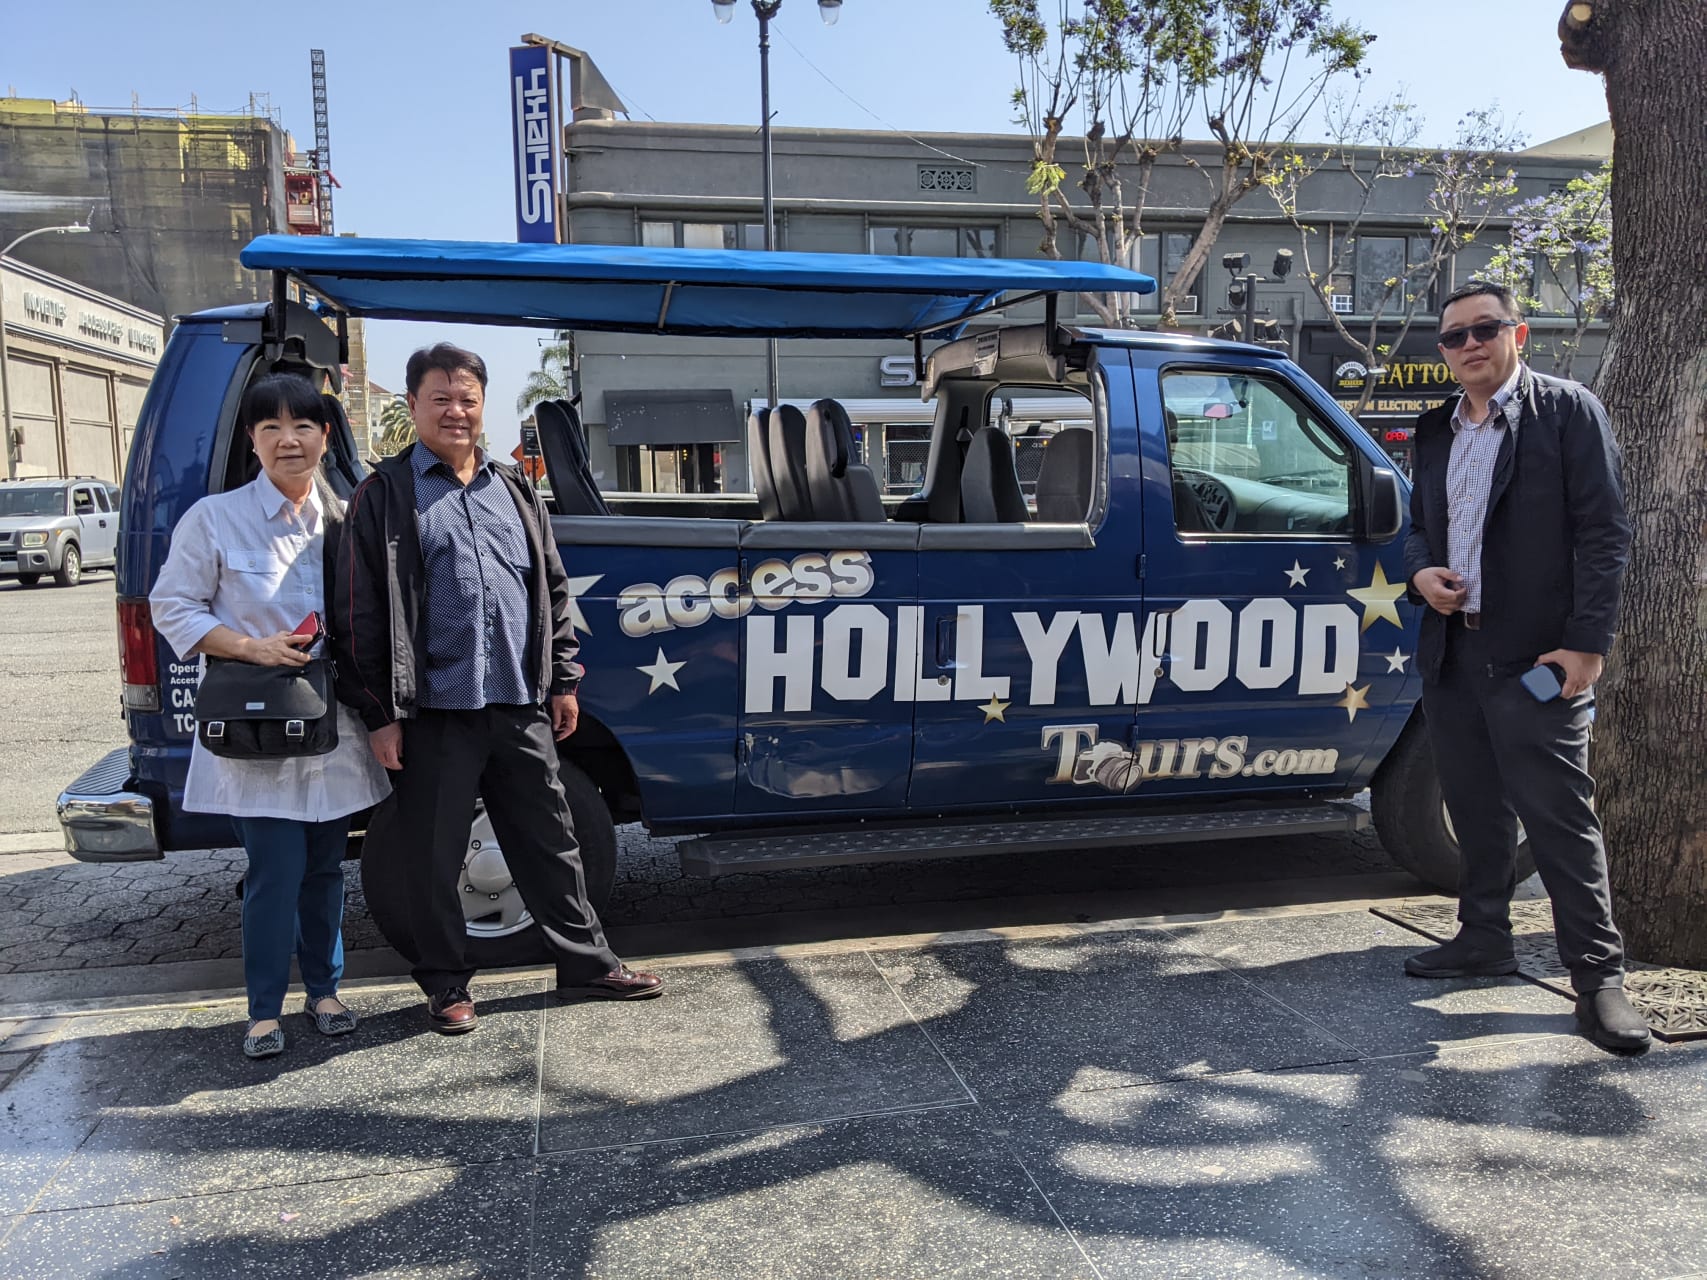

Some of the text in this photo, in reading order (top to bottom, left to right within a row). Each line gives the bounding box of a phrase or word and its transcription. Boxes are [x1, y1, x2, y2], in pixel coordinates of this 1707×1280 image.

[1378, 400, 1422, 411] ELECTRIC
[1385, 431, 1408, 441] OPEN
[617, 550, 875, 638] access
[745, 598, 1359, 714] HOLLYWOOD
